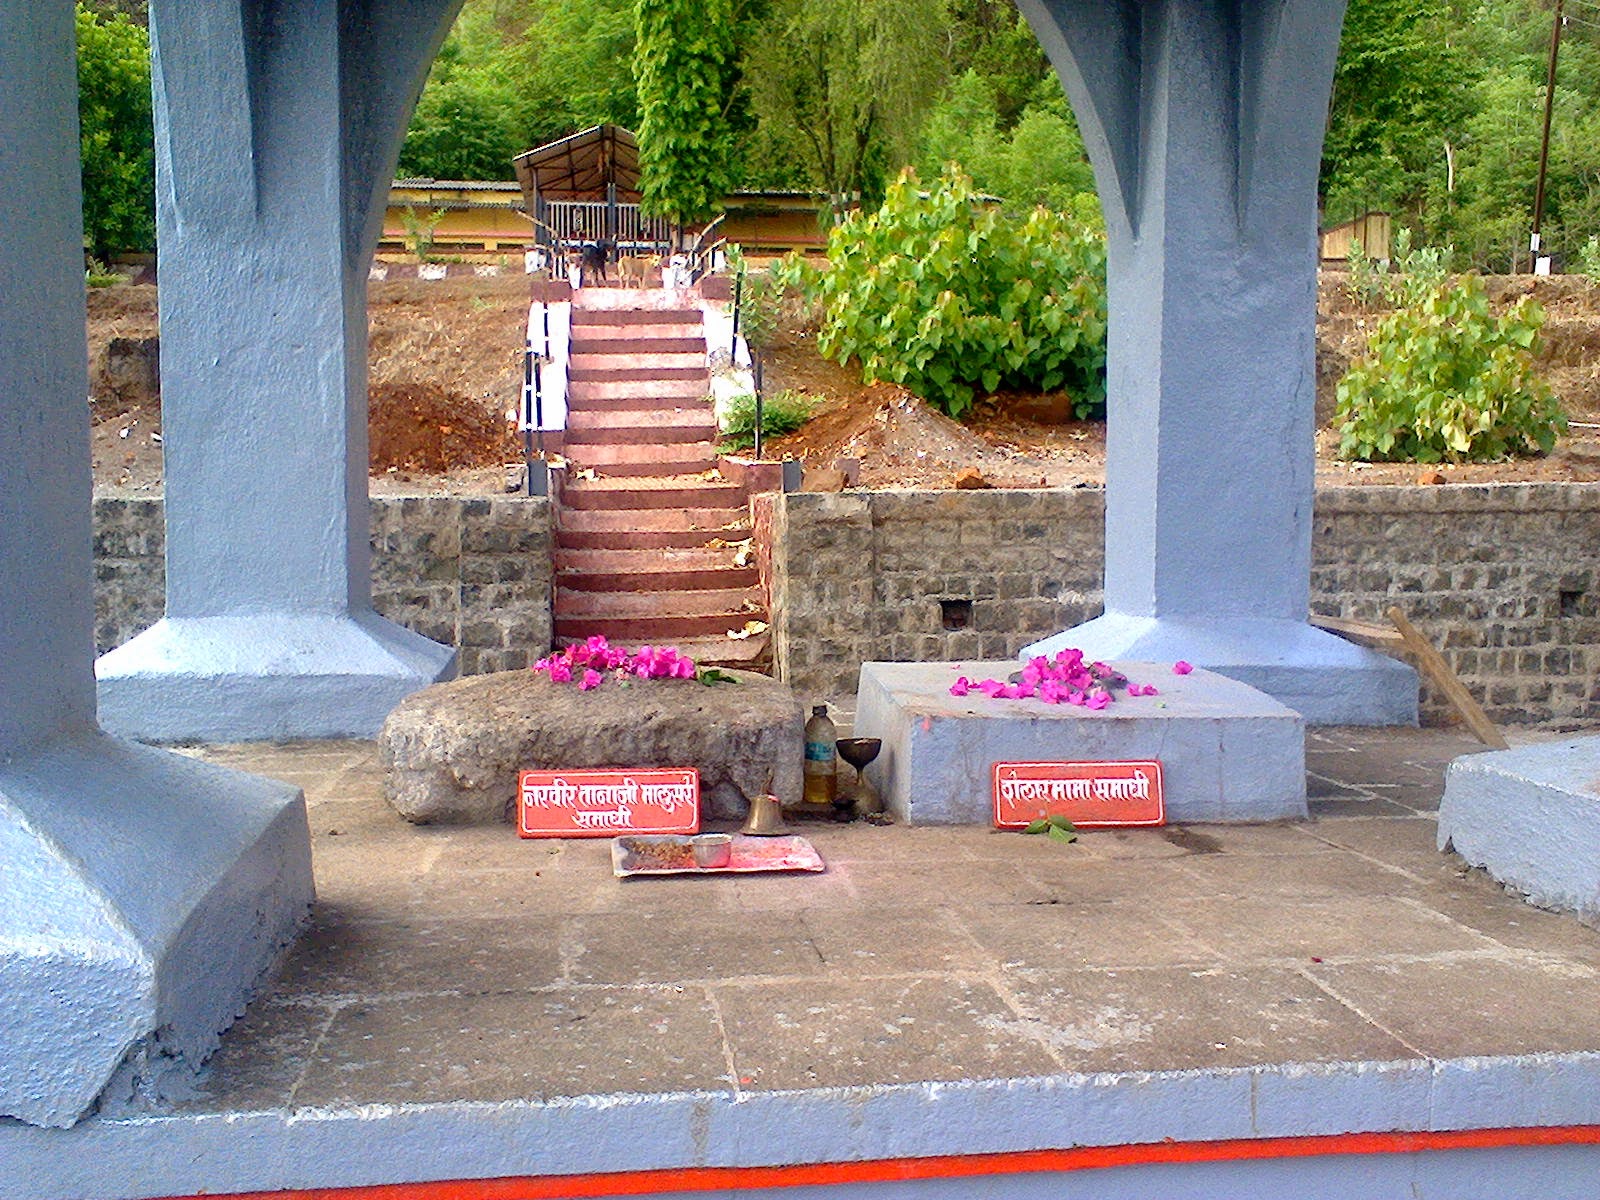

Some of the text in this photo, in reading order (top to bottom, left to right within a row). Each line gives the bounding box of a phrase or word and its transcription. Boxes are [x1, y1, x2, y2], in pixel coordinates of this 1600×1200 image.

[522, 776, 695, 812] नरवीर तानाजी मालुसरे
[1000, 769, 1150, 808] शेलार मामा समाधी
[571, 806, 633, 828] समाधी
